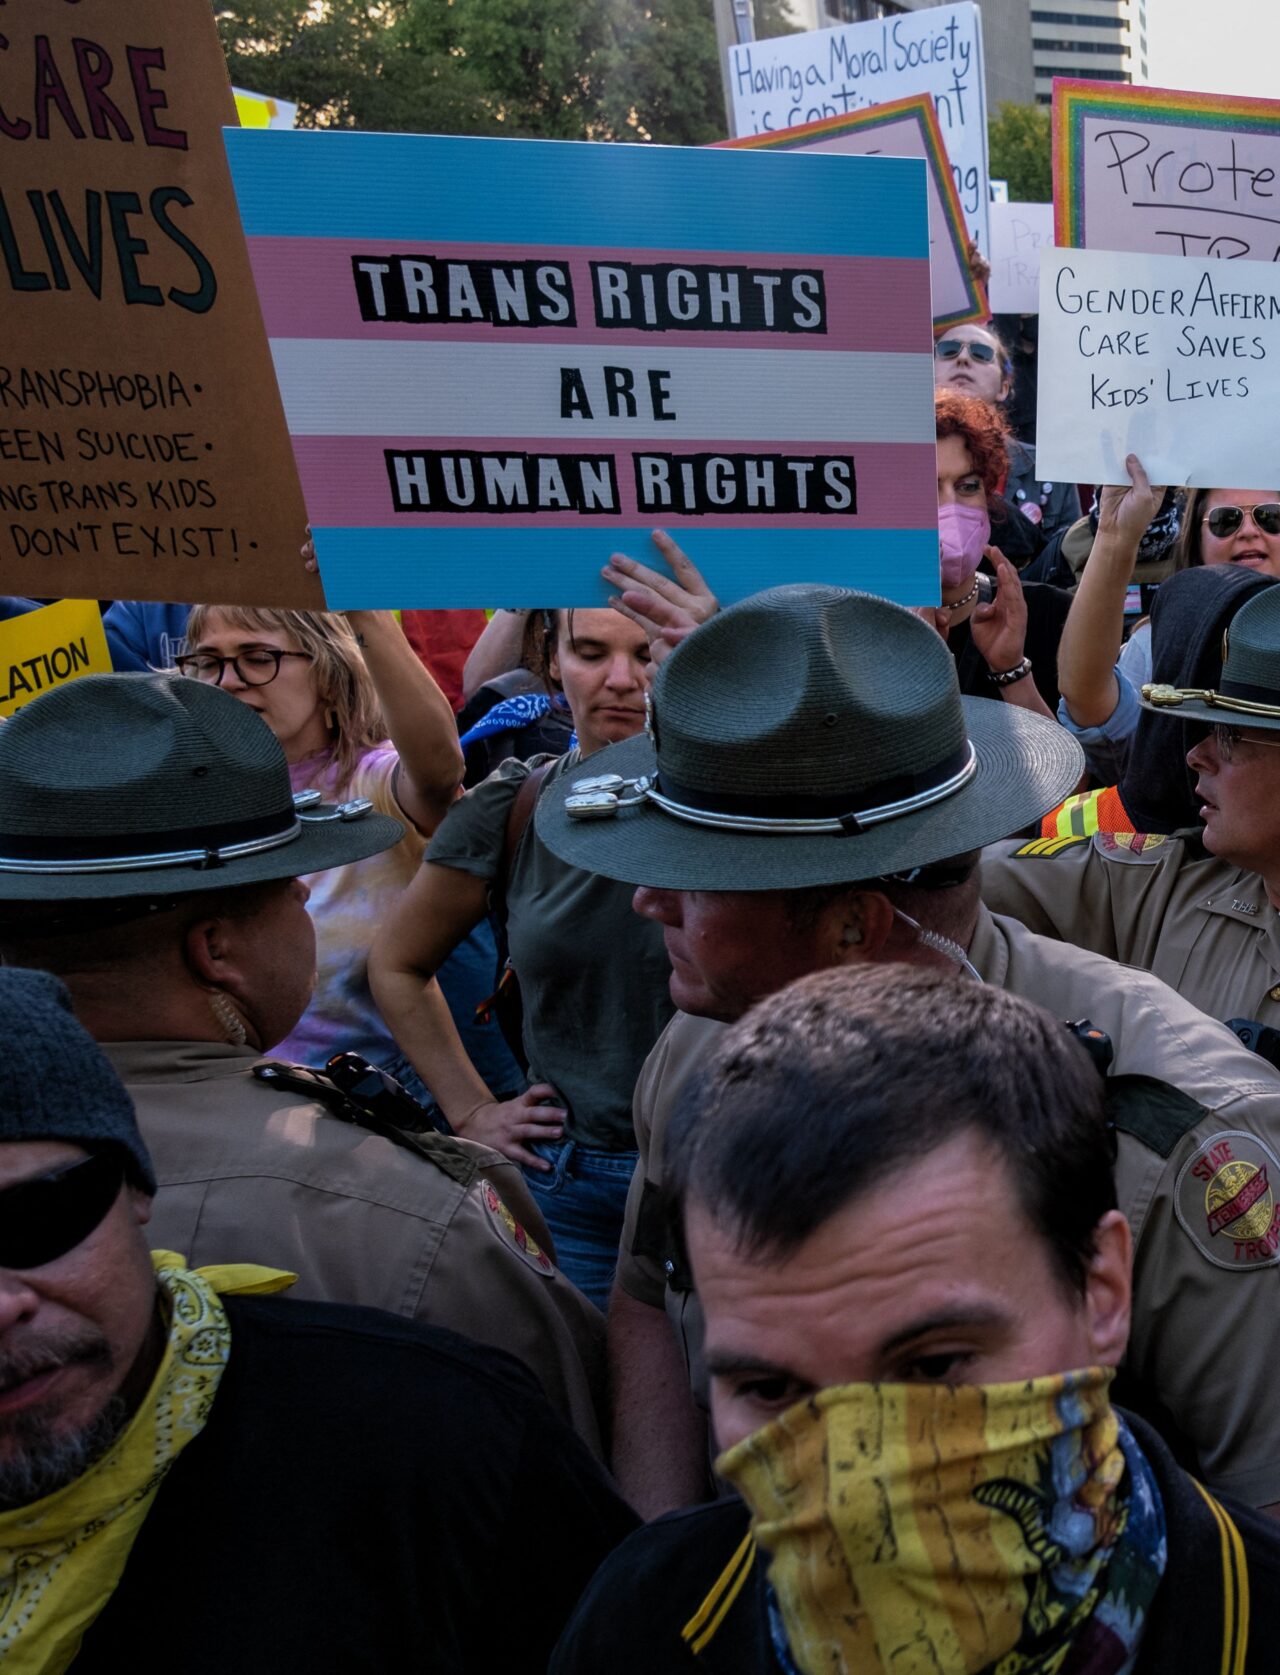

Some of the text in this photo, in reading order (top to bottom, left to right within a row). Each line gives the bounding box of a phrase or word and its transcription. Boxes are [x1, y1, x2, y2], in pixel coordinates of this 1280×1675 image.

[734, 15, 971, 103] Having a Moral Society
[0, 186, 217, 314] LIVES
[358, 259, 821, 328] TRANS RIGHTS
[1056, 266, 1185, 316] GENDER
[1078, 325, 1266, 360] CARE SAVES
[0, 365, 191, 410] RANSPHOBIA
[560, 366, 676, 421] ARE
[1167, 368, 1249, 402] LIVES
[0, 428, 199, 465] EEN SUICIDE
[38, 481, 138, 514] TRANS
[147, 478, 217, 512] KIDS
[393, 456, 851, 510] HUMAN RIGHTS
[10, 522, 102, 557] DON'T
[0, 637, 90, 703] ATION
[1191, 1141, 1235, 1182] STATE
[1212, 1175, 1266, 1226] TENNESSEE
